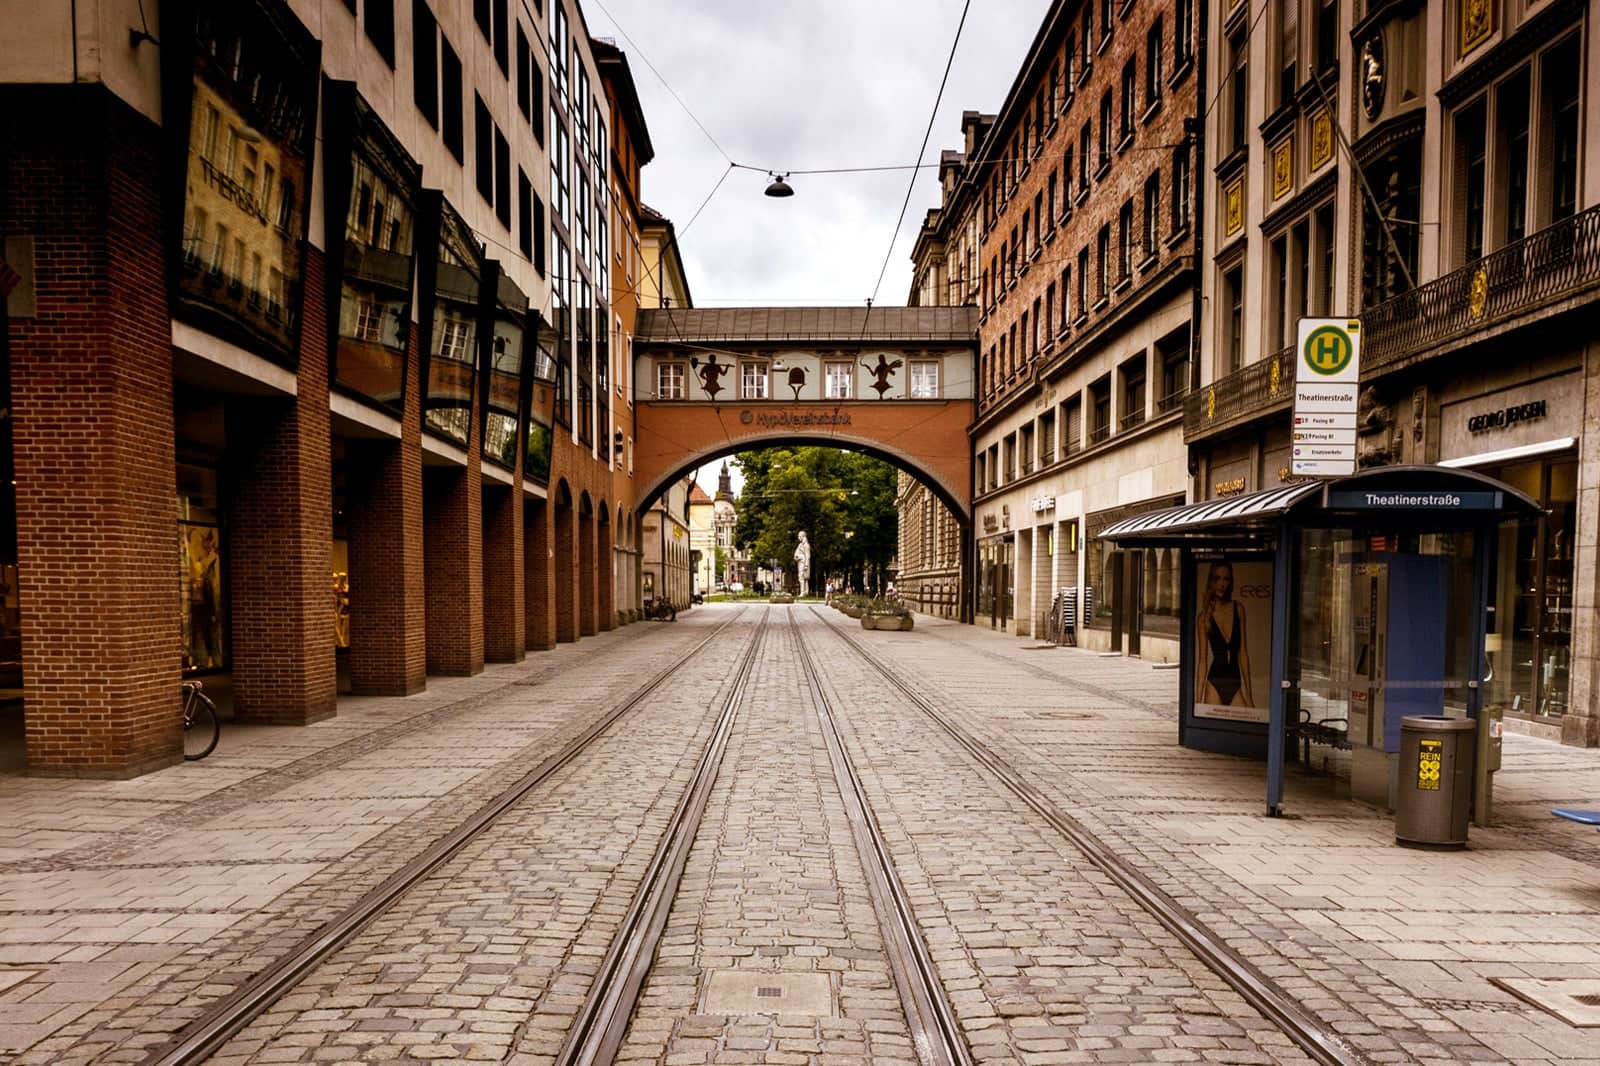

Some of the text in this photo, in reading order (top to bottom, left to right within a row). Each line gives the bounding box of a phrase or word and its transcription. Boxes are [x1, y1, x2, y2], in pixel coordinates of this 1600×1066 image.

[1317, 337, 1339, 363] H
[1298, 393, 1353, 402] Theatinerstraße
[1468, 400, 1546, 432] GEORG JENSEN
[1365, 494, 1460, 506] Theatinerstraße
[1240, 584, 1271, 599] ERES
[1420, 751, 1441, 761] REIN
